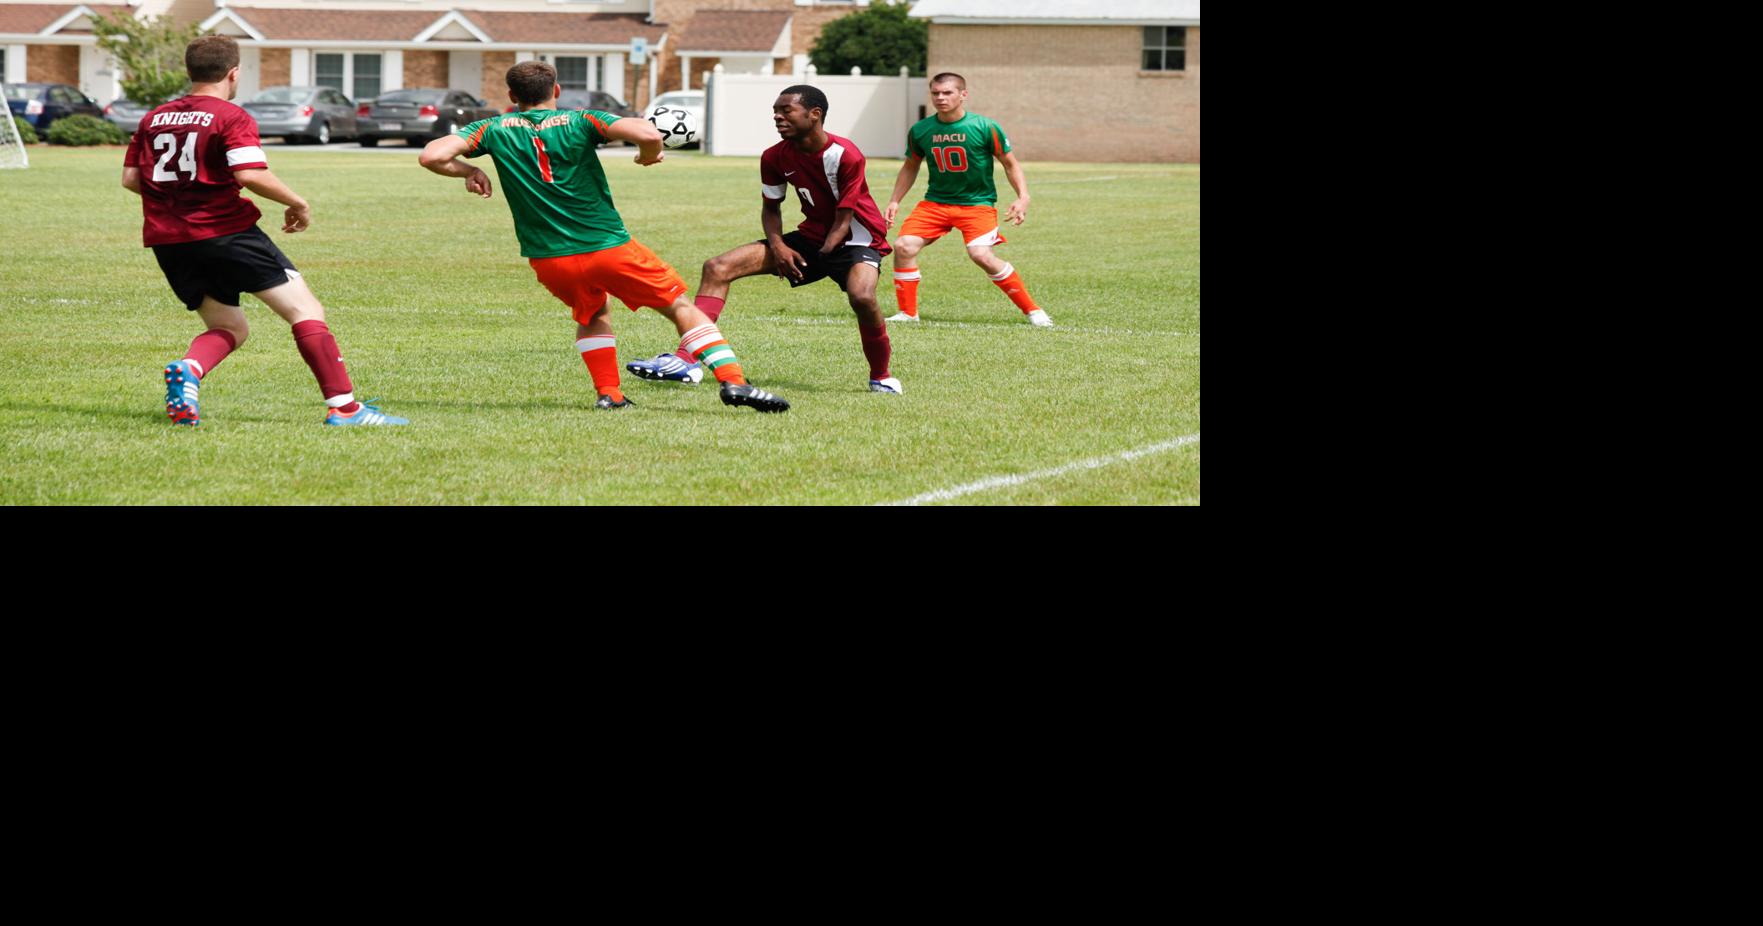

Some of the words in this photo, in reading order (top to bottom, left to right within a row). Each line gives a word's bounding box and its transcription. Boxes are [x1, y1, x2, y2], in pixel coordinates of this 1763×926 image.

[150, 110, 214, 128] KNIGHTS
[932, 133, 966, 143] MACU
[152, 132, 198, 182] 24
[532, 136, 554, 183] 1
[931, 146, 968, 173] 10
